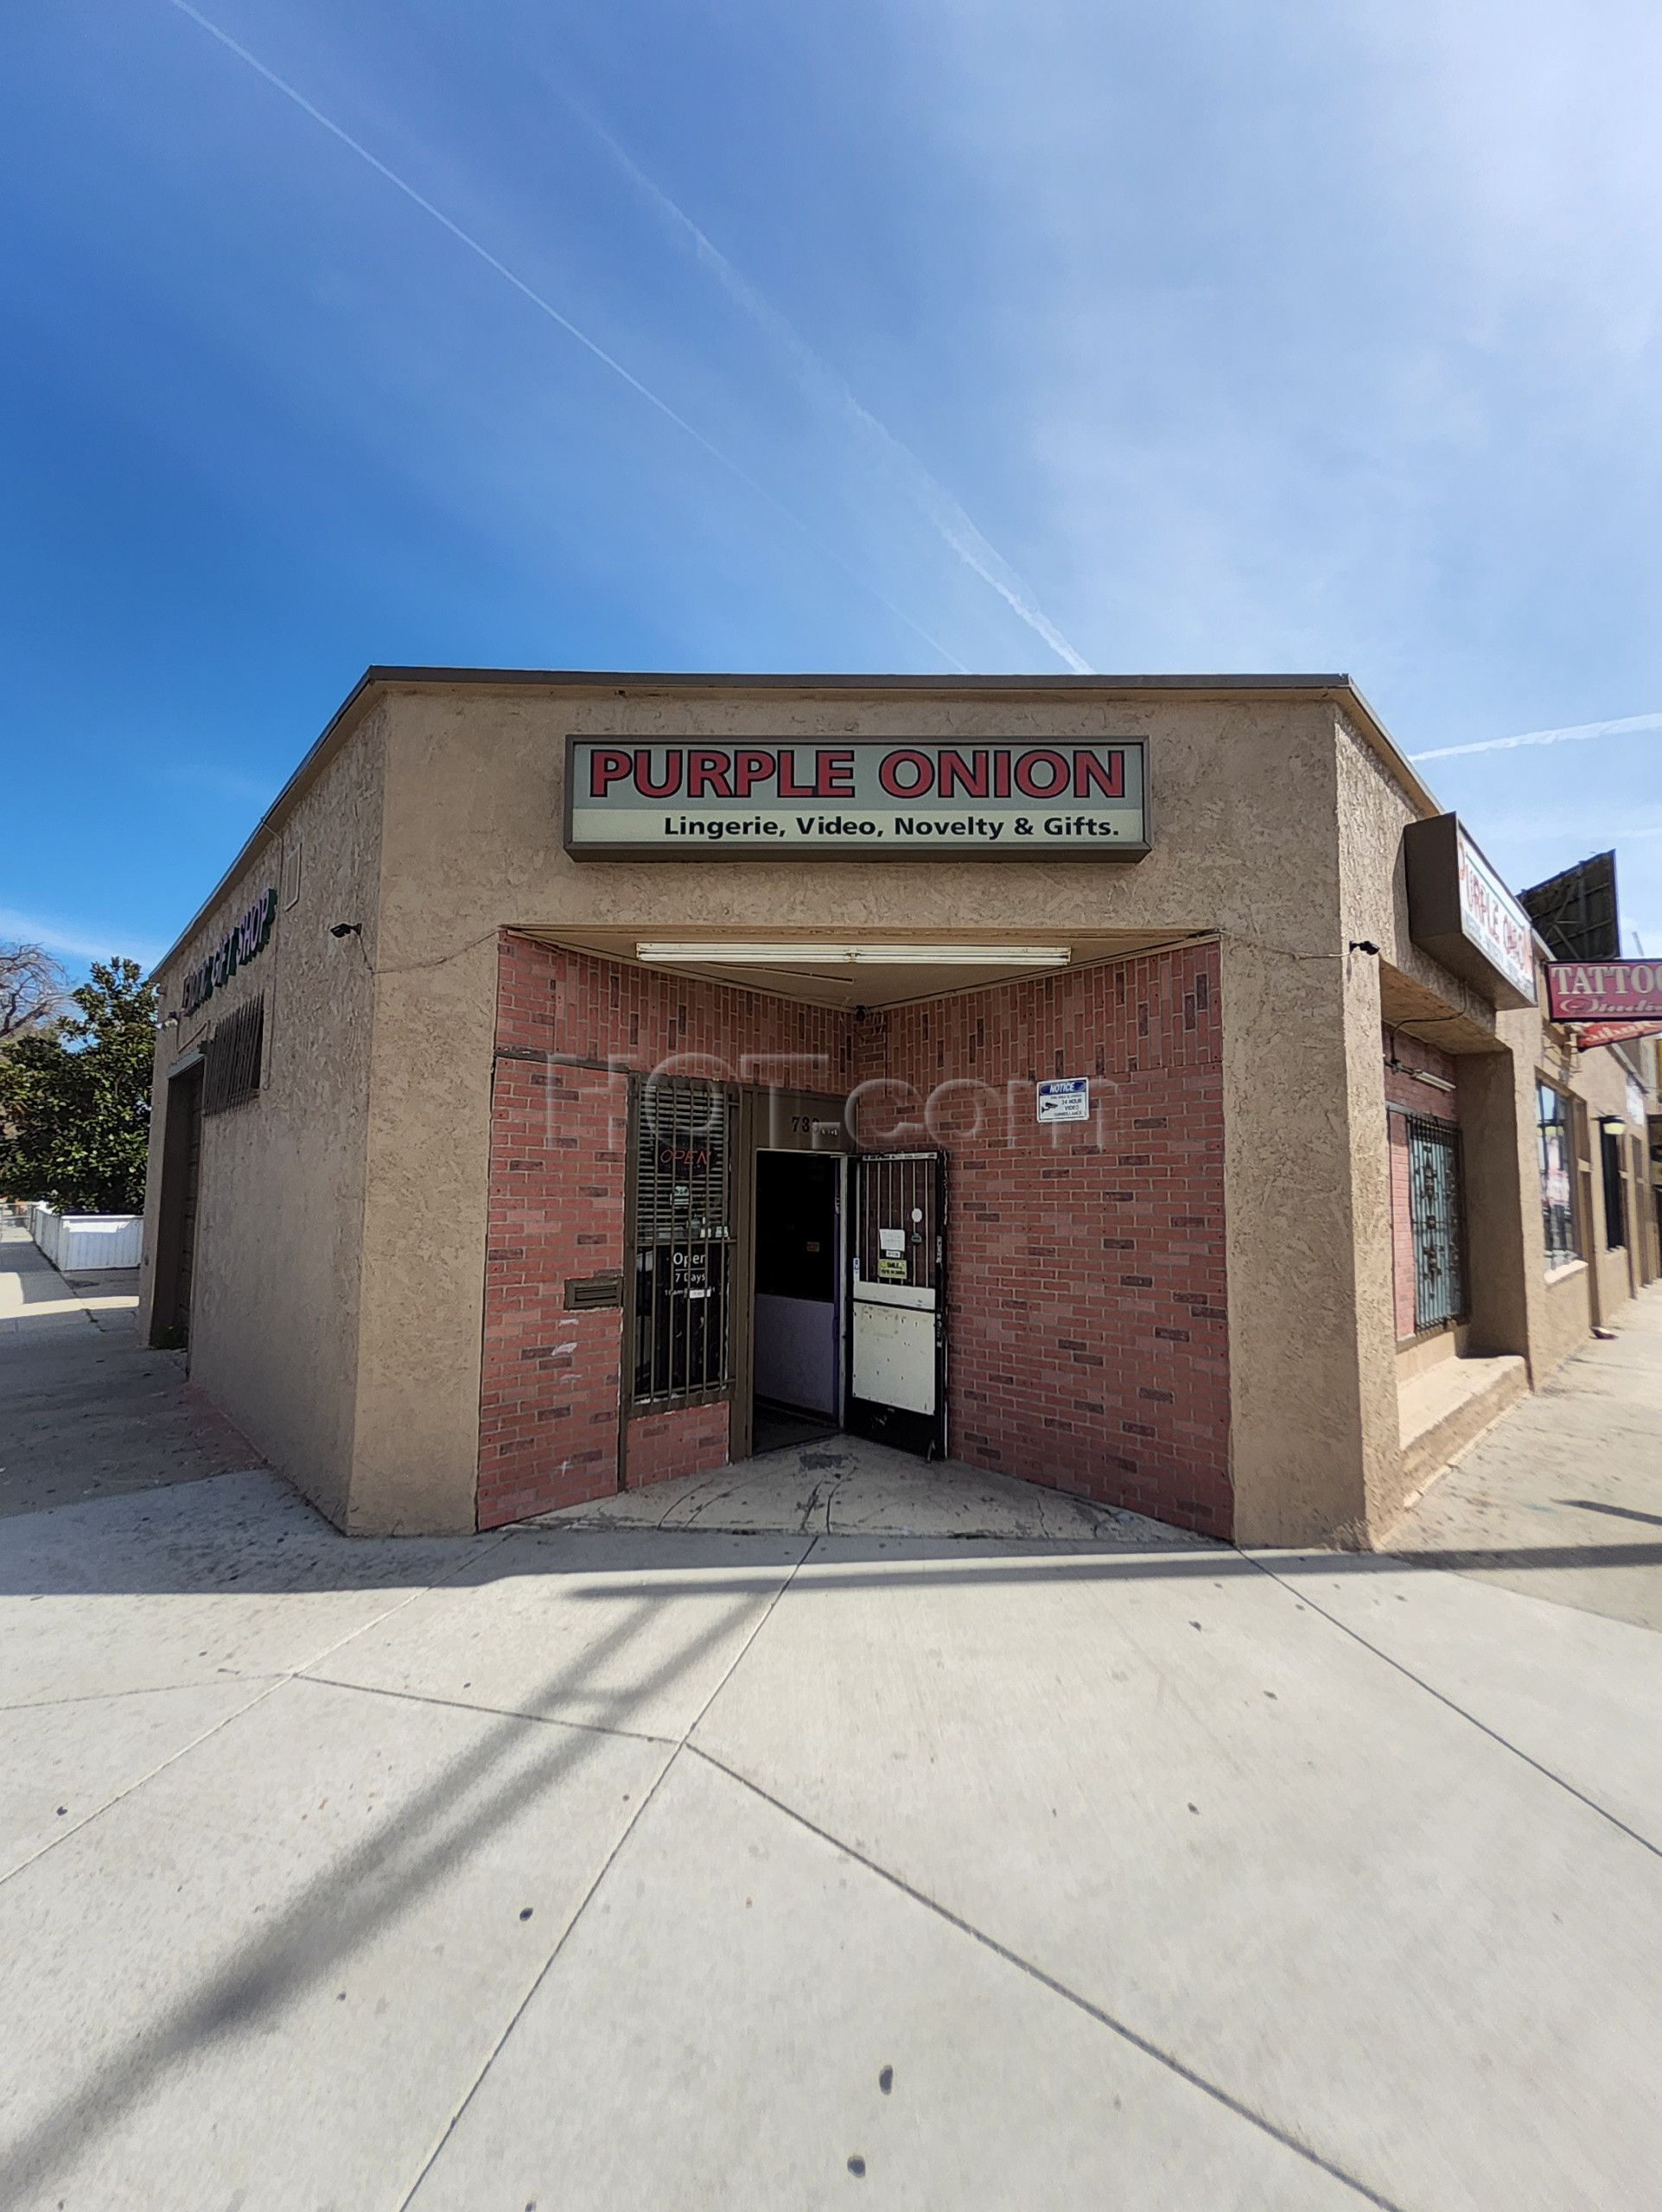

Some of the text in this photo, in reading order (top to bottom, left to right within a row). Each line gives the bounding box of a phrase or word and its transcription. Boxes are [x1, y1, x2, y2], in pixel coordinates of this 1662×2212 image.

[589, 749, 1126, 798] PURPLE ONION
[664, 817, 1120, 841] Lingerie, Video, Novelty & Gifts.
[236, 887, 277, 965] SHOP
[1551, 965, 1662, 995] TATTO
[1050, 1082, 1075, 1093] NOTICE
